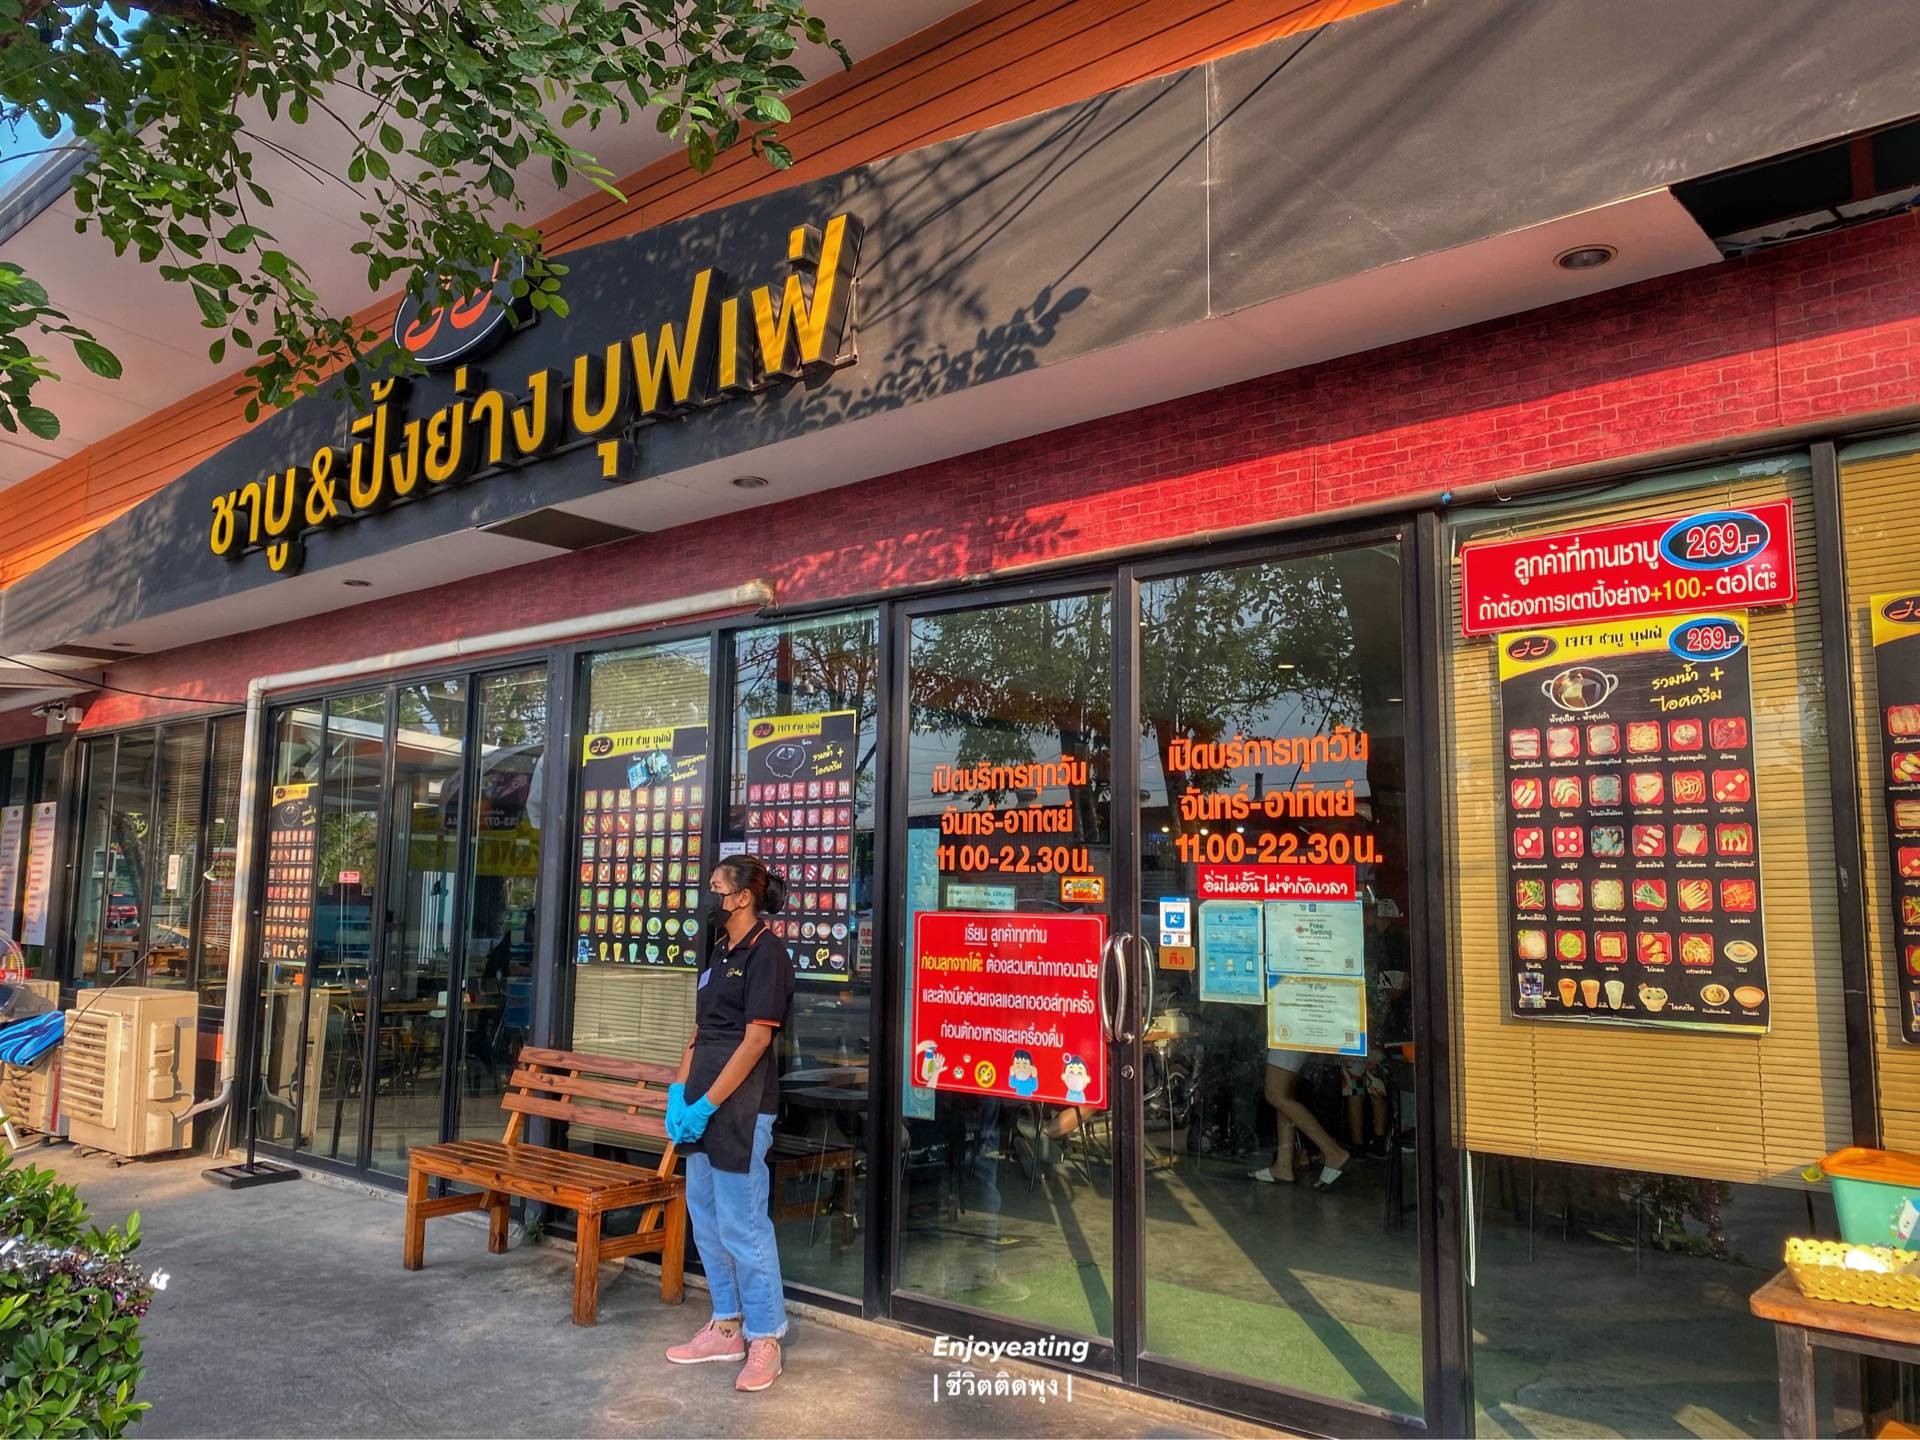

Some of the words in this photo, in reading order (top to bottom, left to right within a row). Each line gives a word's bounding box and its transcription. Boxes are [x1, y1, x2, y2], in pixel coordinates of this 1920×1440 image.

[573, 214, 848, 478] บุฟเฟ่
[1514, 537, 1659, 585] ลูกค้าที่ทานชาบู
[1687, 522, 1760, 559] 269.-
[1600, 631, 1624, 648] ชาบู
[1687, 627, 1739, 651] 269.-
[1651, 662, 1698, 690] รวมน้ำ
[933, 754, 1087, 795] เปิดบริการทุกวัน
[1180, 779, 1355, 821] จันทร์-อาทิตย์
[942, 800, 1073, 835] จันทร์-อาทิตย์
[1203, 870, 1259, 894] อิ่มไม่อั้น
[1255, 873, 1348, 895] ไม่จำกัดเวลา
[965, 924, 987, 943] เรียน
[991, 925, 1047, 948] ลูกค้าทุกท่าน
[921, 952, 983, 976] ก่อนลุกจากโต๊ะ
[986, 953, 1098, 979] ต้องสวมหน้ากากอนามัย
[923, 984, 1094, 1018] และล้างมือด้วยเจลแอลกอฮอล์ทุกครั้ง
[940, 1021, 1063, 1048] ก่อนตักอาหารและเครื่องดื่ม
